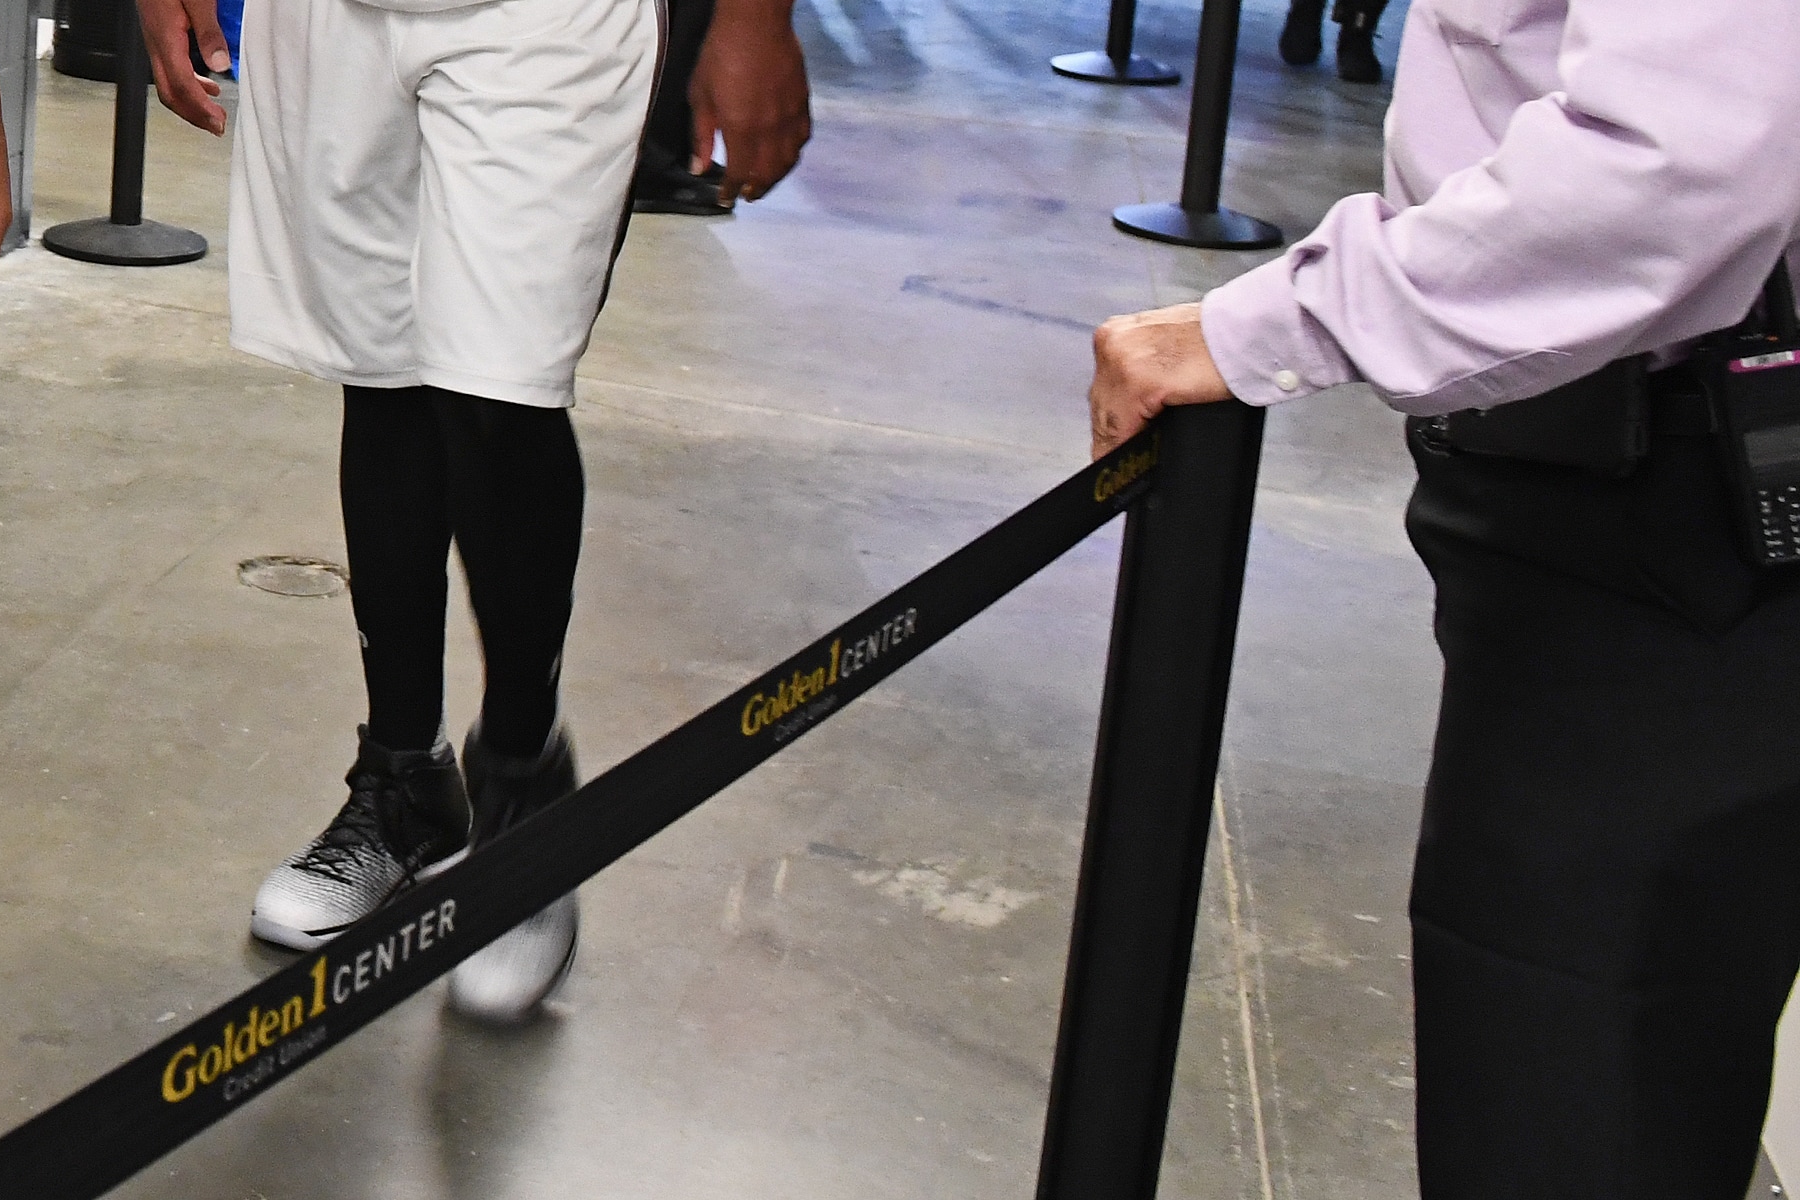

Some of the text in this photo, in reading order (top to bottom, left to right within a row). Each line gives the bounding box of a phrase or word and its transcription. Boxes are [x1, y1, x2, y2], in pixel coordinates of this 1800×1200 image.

[840, 607, 918, 678] CENTER
[161, 995, 304, 1103] Golden
[332, 898, 457, 1005] CENTER
